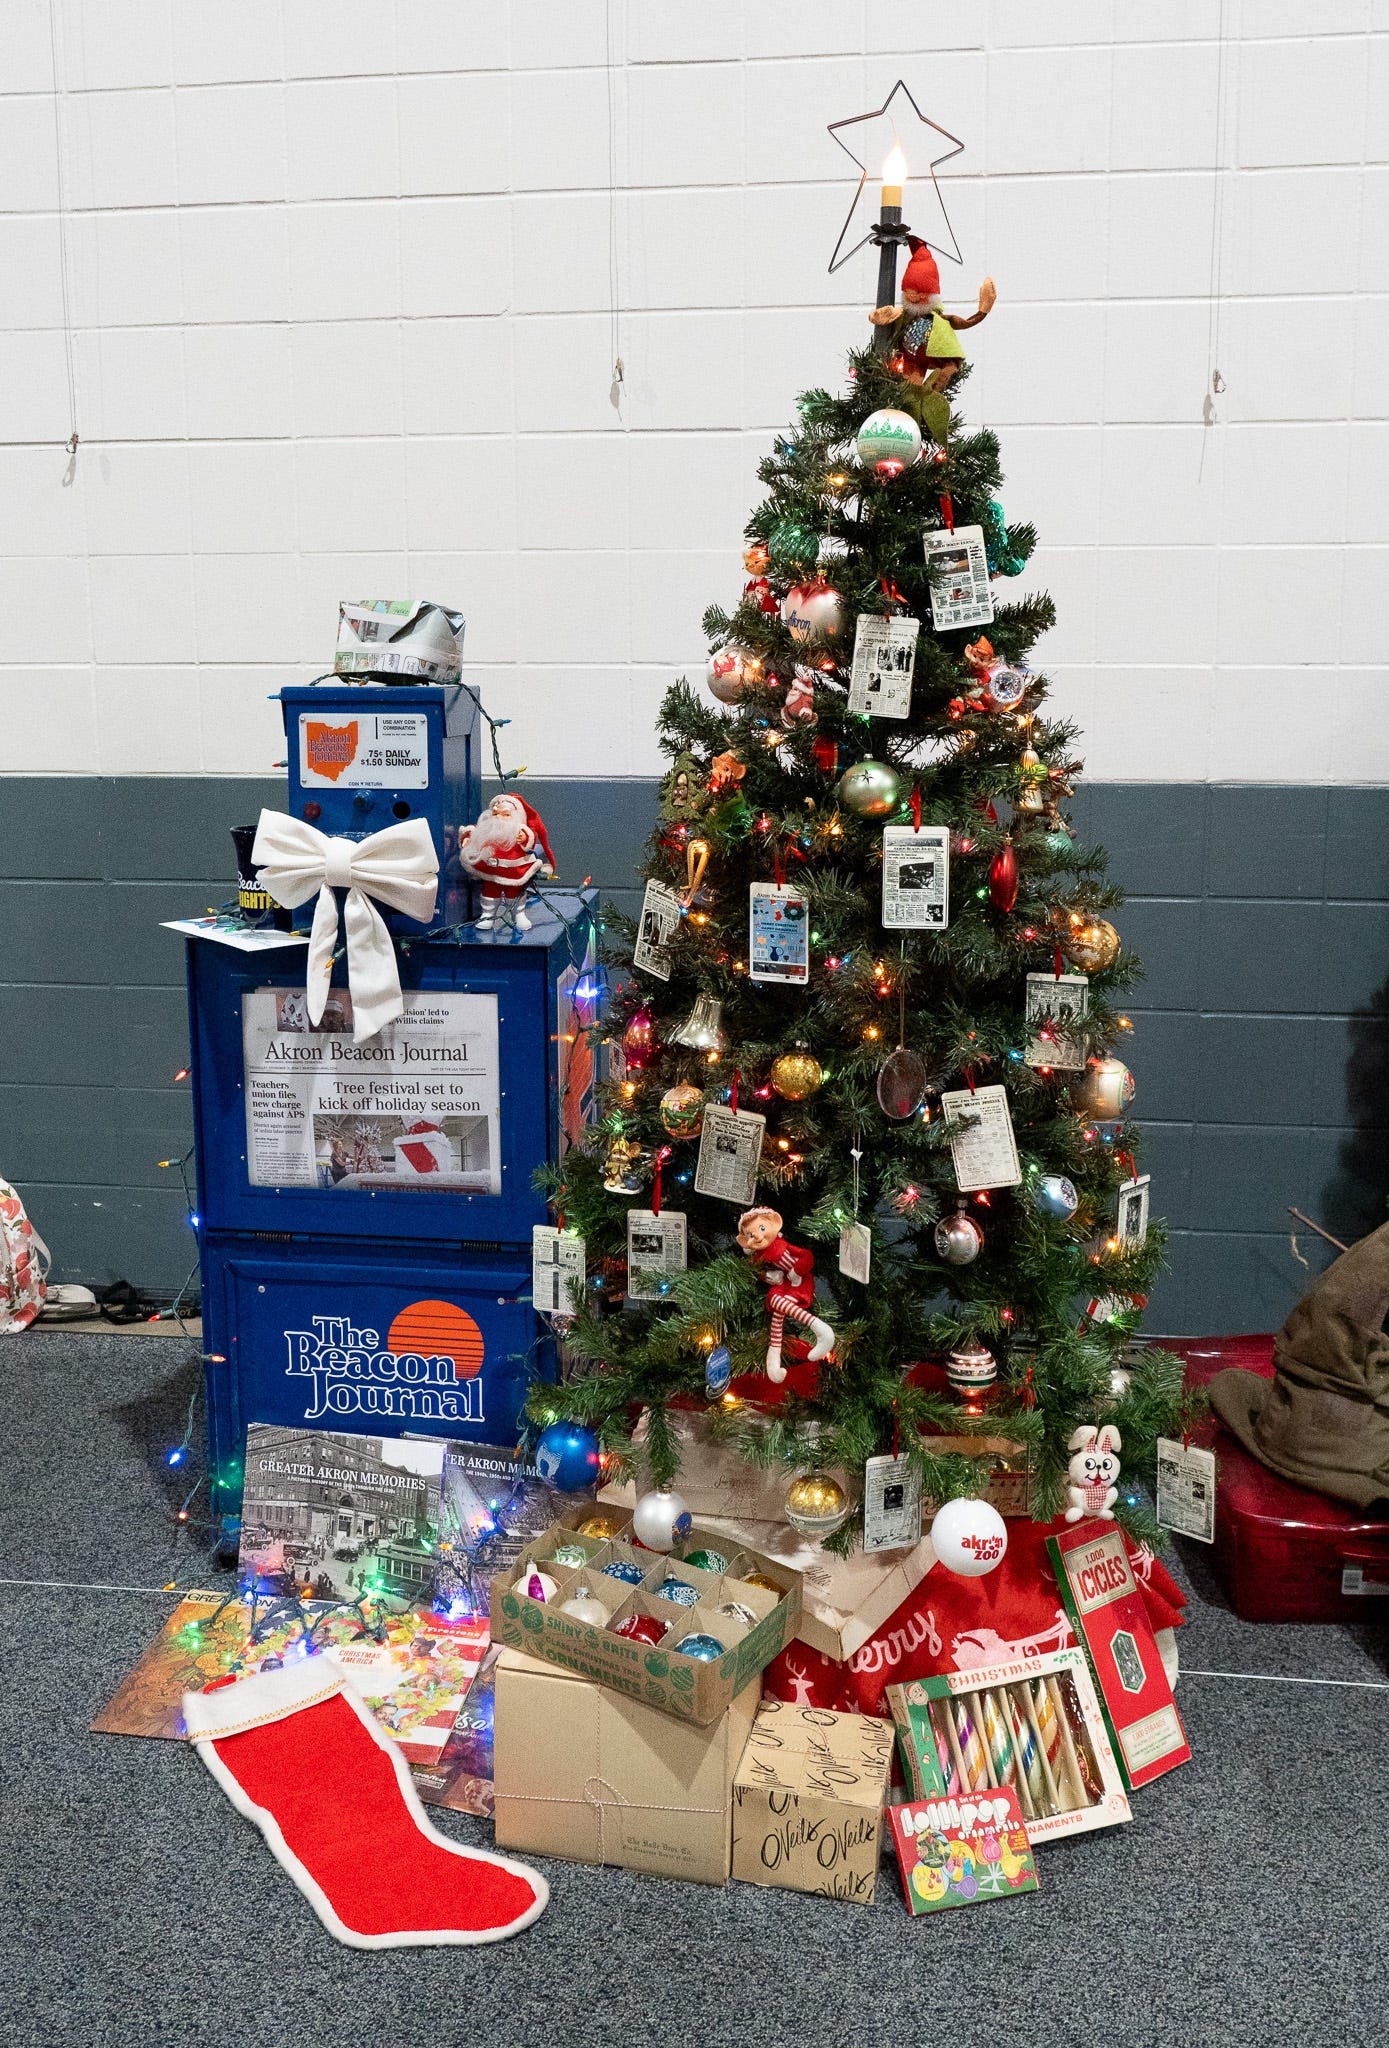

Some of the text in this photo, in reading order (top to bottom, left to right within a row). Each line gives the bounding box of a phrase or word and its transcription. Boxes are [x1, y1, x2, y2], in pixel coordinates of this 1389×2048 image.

[787, 609, 811, 630] Akron
[319, 730, 351, 744] Akron
[309, 739, 348, 752] Beacon
[385, 749, 411, 758] DAILY
[360, 758, 422, 767] $1.50 SUNDAY
[428, 1008, 440, 1016] led
[395, 1017, 445, 1025] Willis claims
[264, 1041, 469, 1064] Akron Beacon Journal
[251, 1080, 290, 1089] Teachers
[333, 1081, 464, 1095] Tree festival set to
[252, 1090, 297, 1099] union files
[252, 1100, 301, 1110] new charge
[318, 1097, 480, 1113] kick off holiday season
[253, 1110, 305, 1119] against APS
[312, 1315, 380, 1350] The
[284, 1330, 460, 1386] Beacon
[304, 1367, 486, 1423] Journal
[467, 1456, 506, 1473] AKRON
[259, 1459, 426, 1491] GREATER AKRON MEMORIES
[973, 1549, 1000, 1561] zoo
[1076, 1555, 1127, 1602] ICICLES
[426, 1626, 481, 1637] Firestone
[546, 1615, 639, 1662] SHINY BRITE
[821, 1610, 943, 1674] erry
[338, 1649, 382, 1659] CHRISTMAS
[340, 1656, 374, 1665] AMERICA
[545, 1648, 641, 1695] ORNAMENTS
[947, 1659, 1043, 1689] CHRISTMAS
[900, 1797, 1011, 1838] lollipop
[1028, 1814, 1083, 1834] NAMENTS
